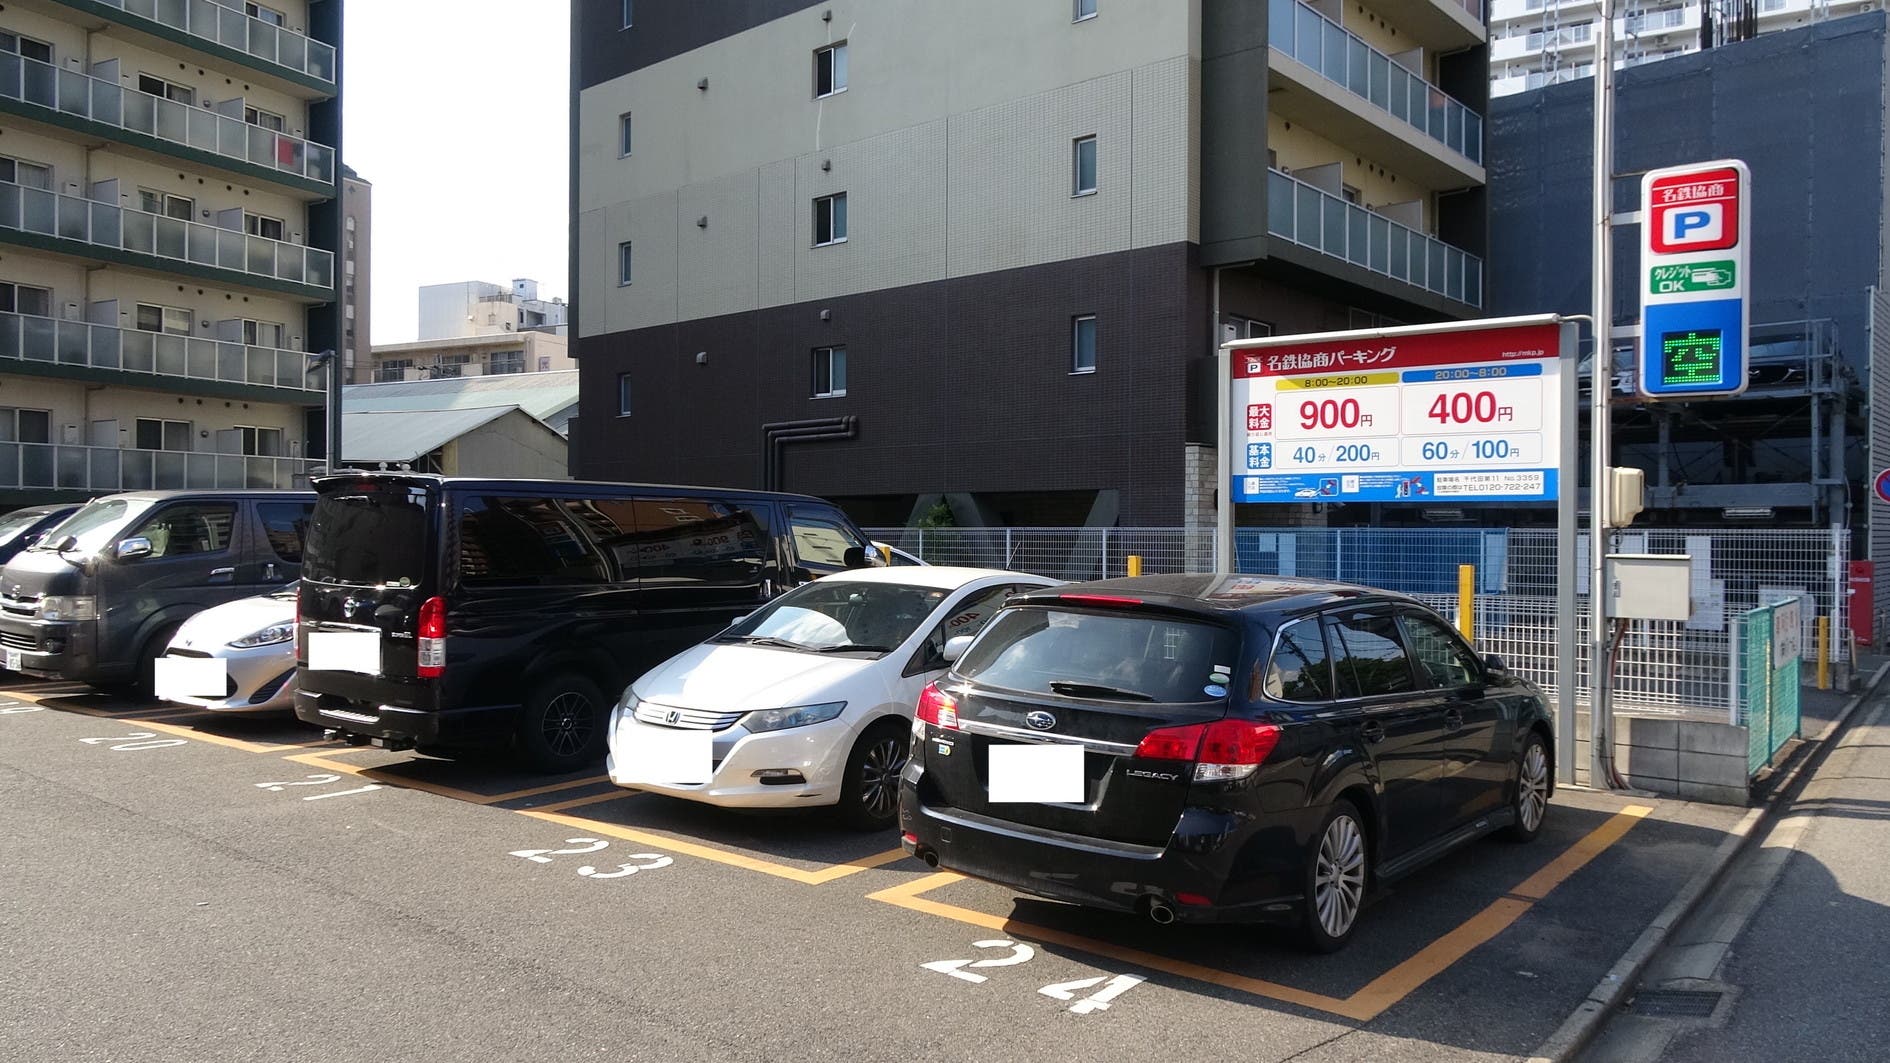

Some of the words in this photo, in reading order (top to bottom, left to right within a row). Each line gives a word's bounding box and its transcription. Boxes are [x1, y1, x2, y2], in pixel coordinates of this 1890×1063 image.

[1662, 183, 1724, 203] 名鉄協商
[1674, 211, 1711, 239] P
[1654, 266, 1691, 280] クレジット
[1659, 280, 1686, 292] OK
[1267, 346, 1397, 371] 名鉄協商パーキング
[1664, 332, 1720, 384] 空
[78, 732, 187, 751] 20
[255, 774, 383, 801] 21
[1126, 769, 1179, 781] LEGACY
[508, 837, 673, 879] 23
[919, 939, 1148, 1014] 24
